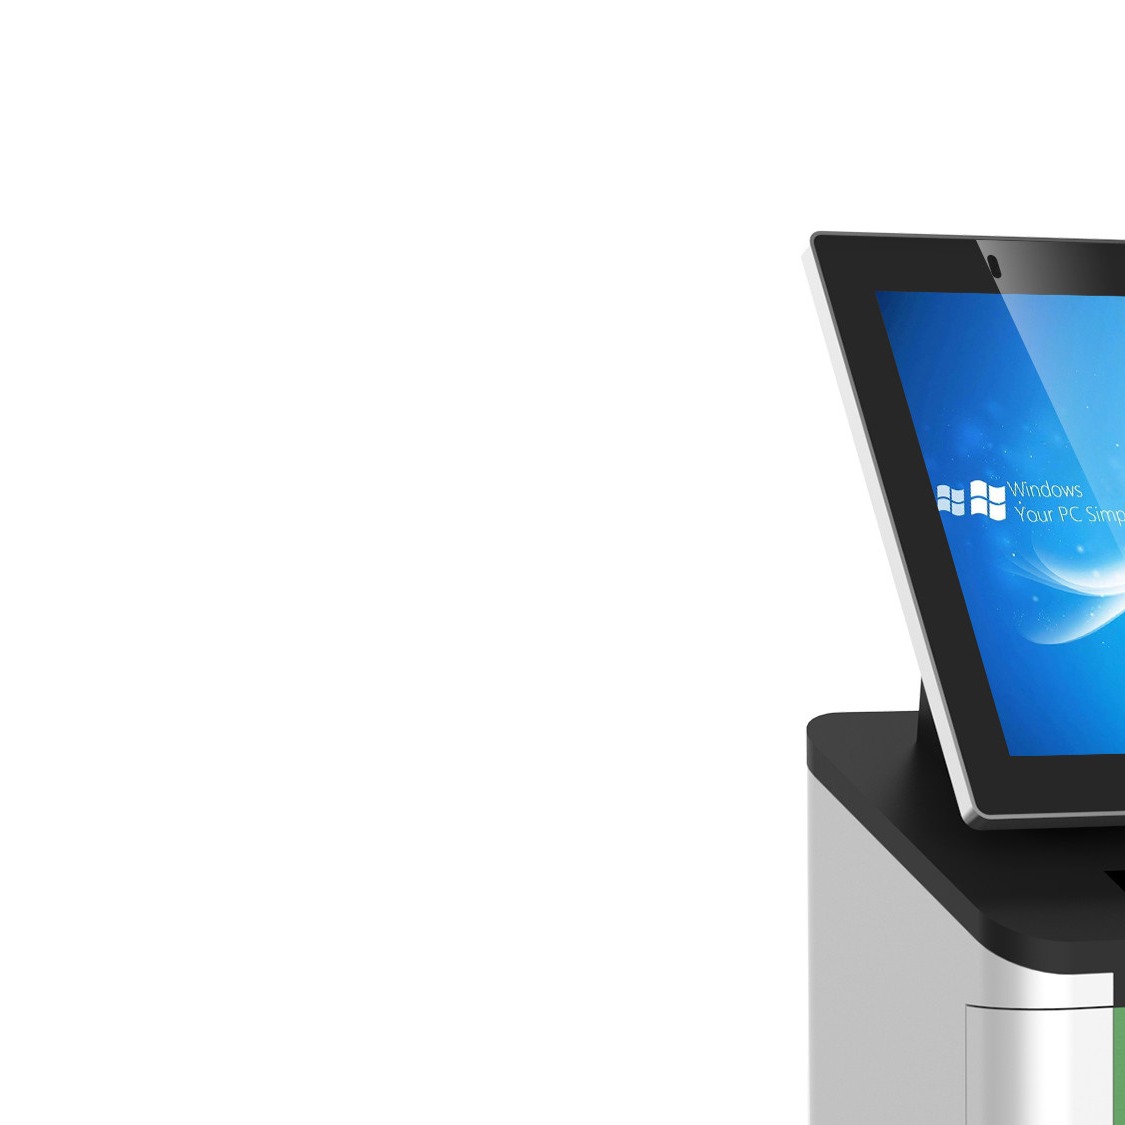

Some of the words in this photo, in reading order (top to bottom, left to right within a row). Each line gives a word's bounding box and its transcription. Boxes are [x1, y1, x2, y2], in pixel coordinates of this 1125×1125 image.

[1007, 480, 1083, 498] Windows
[1014, 506, 1053, 523] Your
[1059, 506, 1083, 523] PC
